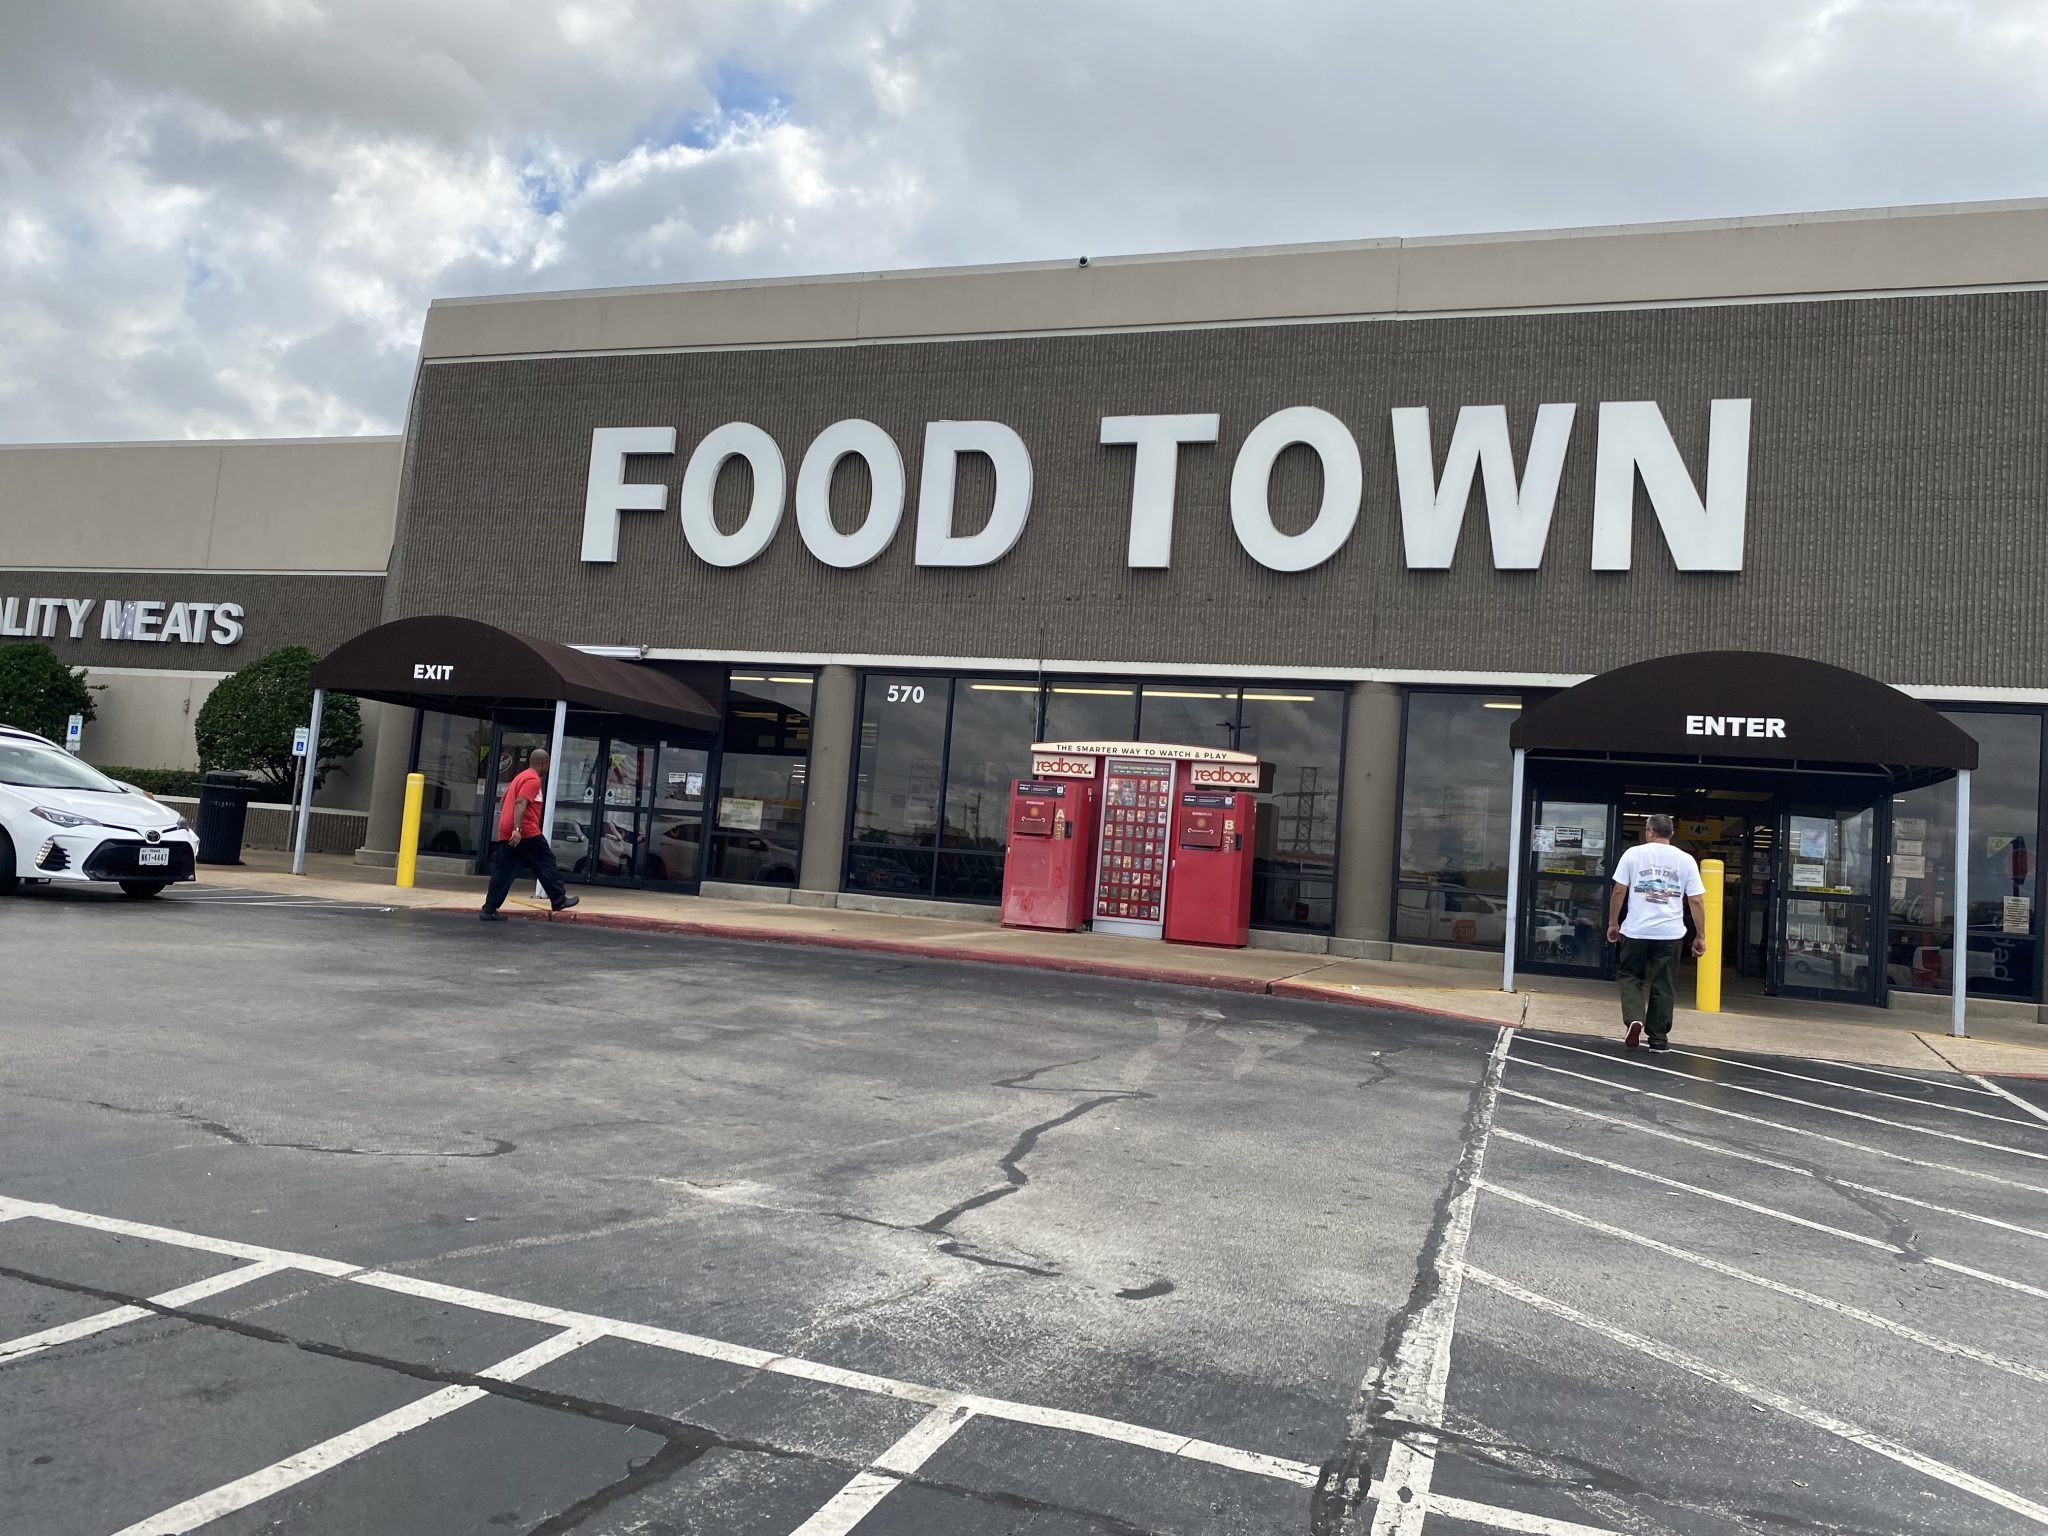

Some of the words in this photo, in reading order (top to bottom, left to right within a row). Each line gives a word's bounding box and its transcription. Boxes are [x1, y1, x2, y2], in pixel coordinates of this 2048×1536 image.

[580, 418, 1034, 569] FOOD
[1100, 398, 1752, 572] TOWN
[0, 597, 96, 638] LITY
[101, 600, 244, 645] MEATS
[413, 664, 454, 680] EXIT
[887, 684, 925, 704] 570
[1686, 715, 1787, 738] ENTER
[1056, 744, 1073, 752] THE
[1076, 745, 1118, 754] SMARTER
[1159, 750, 1191, 758] WATCH
[1204, 752, 1227, 760] PLAY
[1055, 808, 1065, 819] A
[1224, 819, 1234, 830] B
